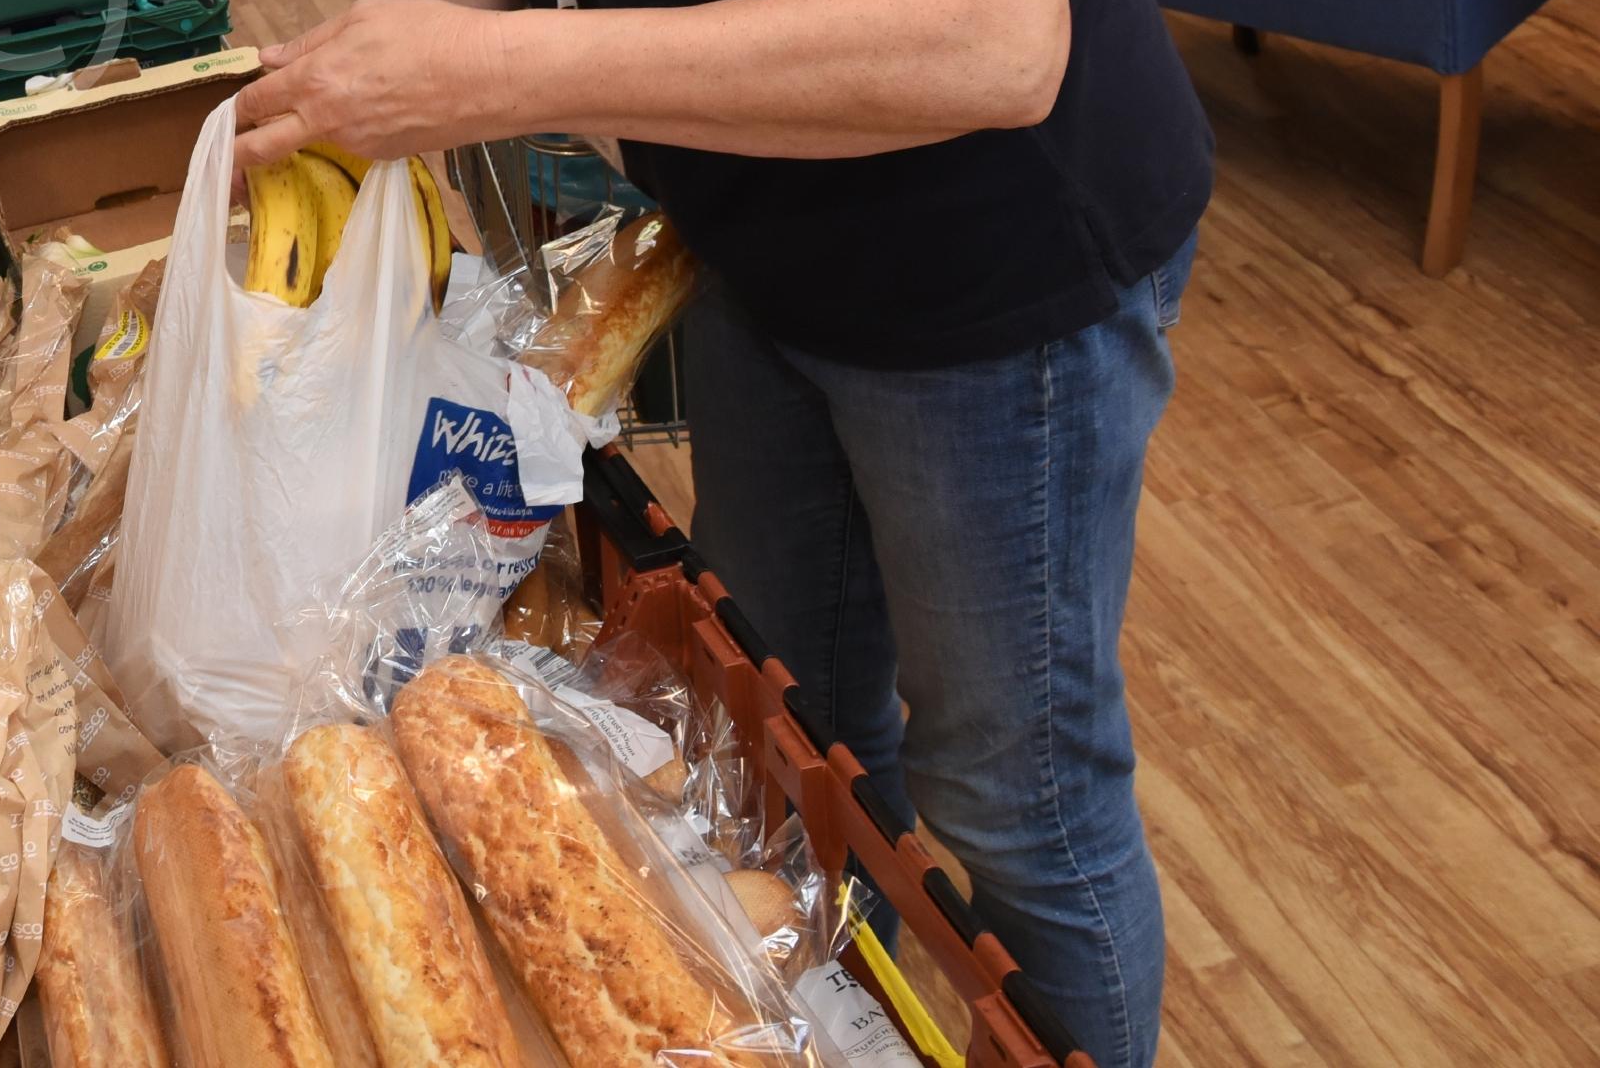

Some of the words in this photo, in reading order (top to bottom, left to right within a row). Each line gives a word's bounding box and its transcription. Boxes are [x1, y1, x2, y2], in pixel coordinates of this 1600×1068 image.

[12, 923, 43, 935] SCO
[0, 996, 18, 1013] TES
[851, 1005, 885, 1030] BA
